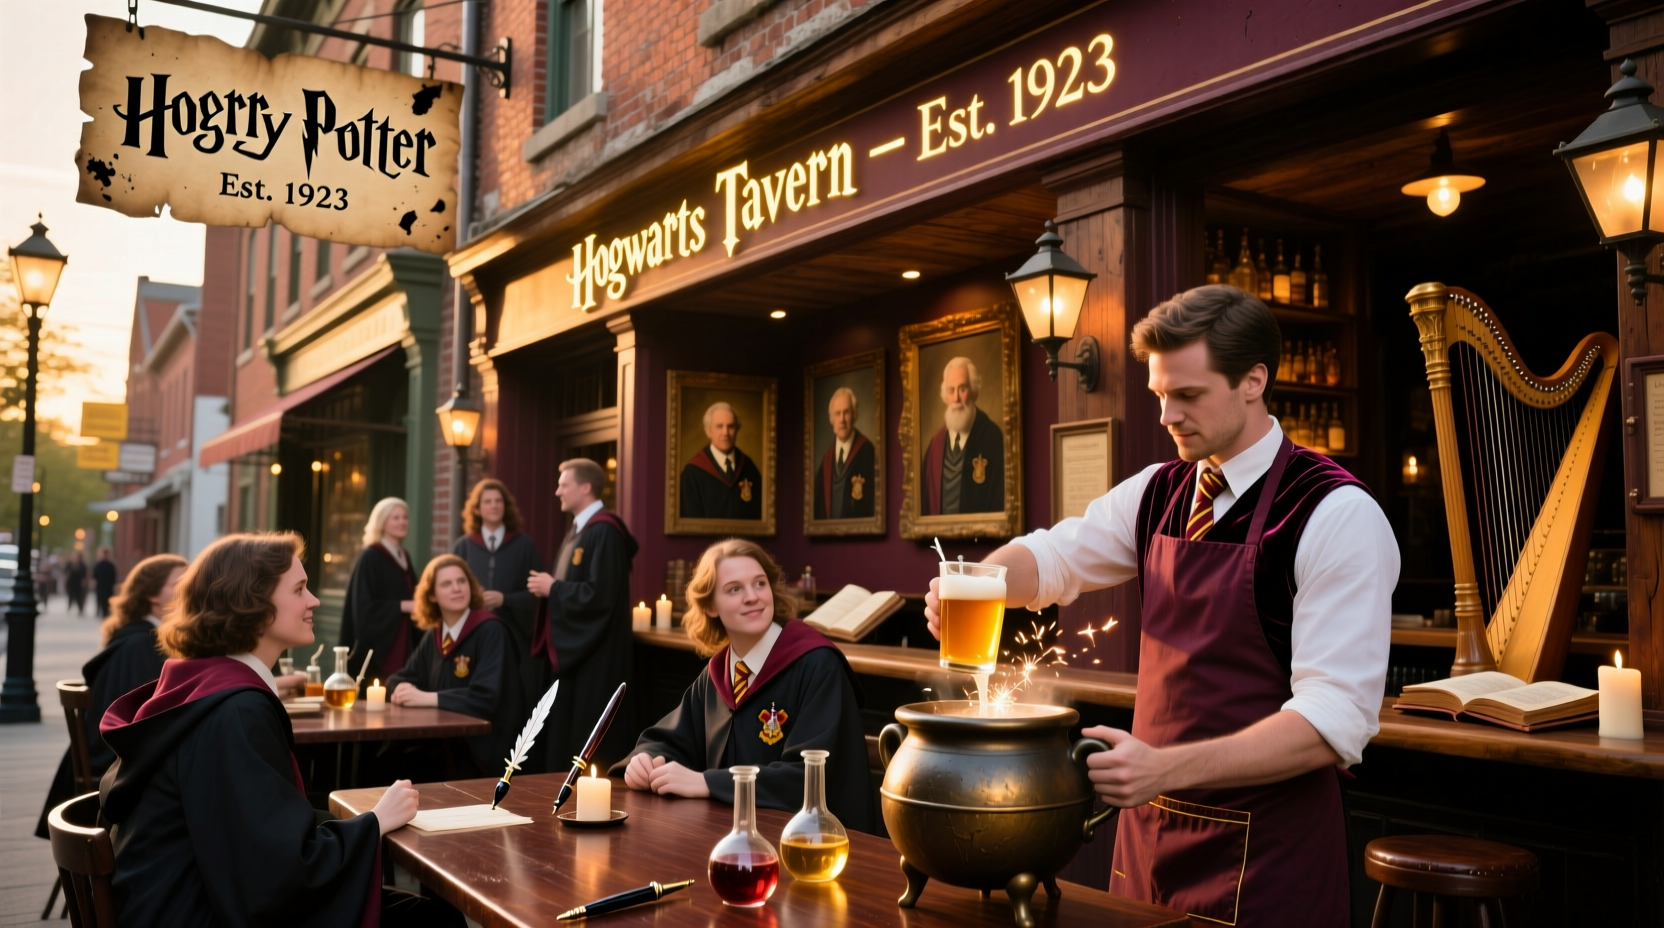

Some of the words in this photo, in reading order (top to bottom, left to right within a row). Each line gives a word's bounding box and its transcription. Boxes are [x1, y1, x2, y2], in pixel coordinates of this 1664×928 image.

[302, 88, 437, 180] Potter
[566, 199, 706, 311] Hogwarts
[715, 142, 857, 258] Tavern
[916, 95, 995, 161] Est.
[1007, 33, 1116, 126] 1923
[219, 172, 273, 201] Est.
[286, 182, 349, 211] 1923
